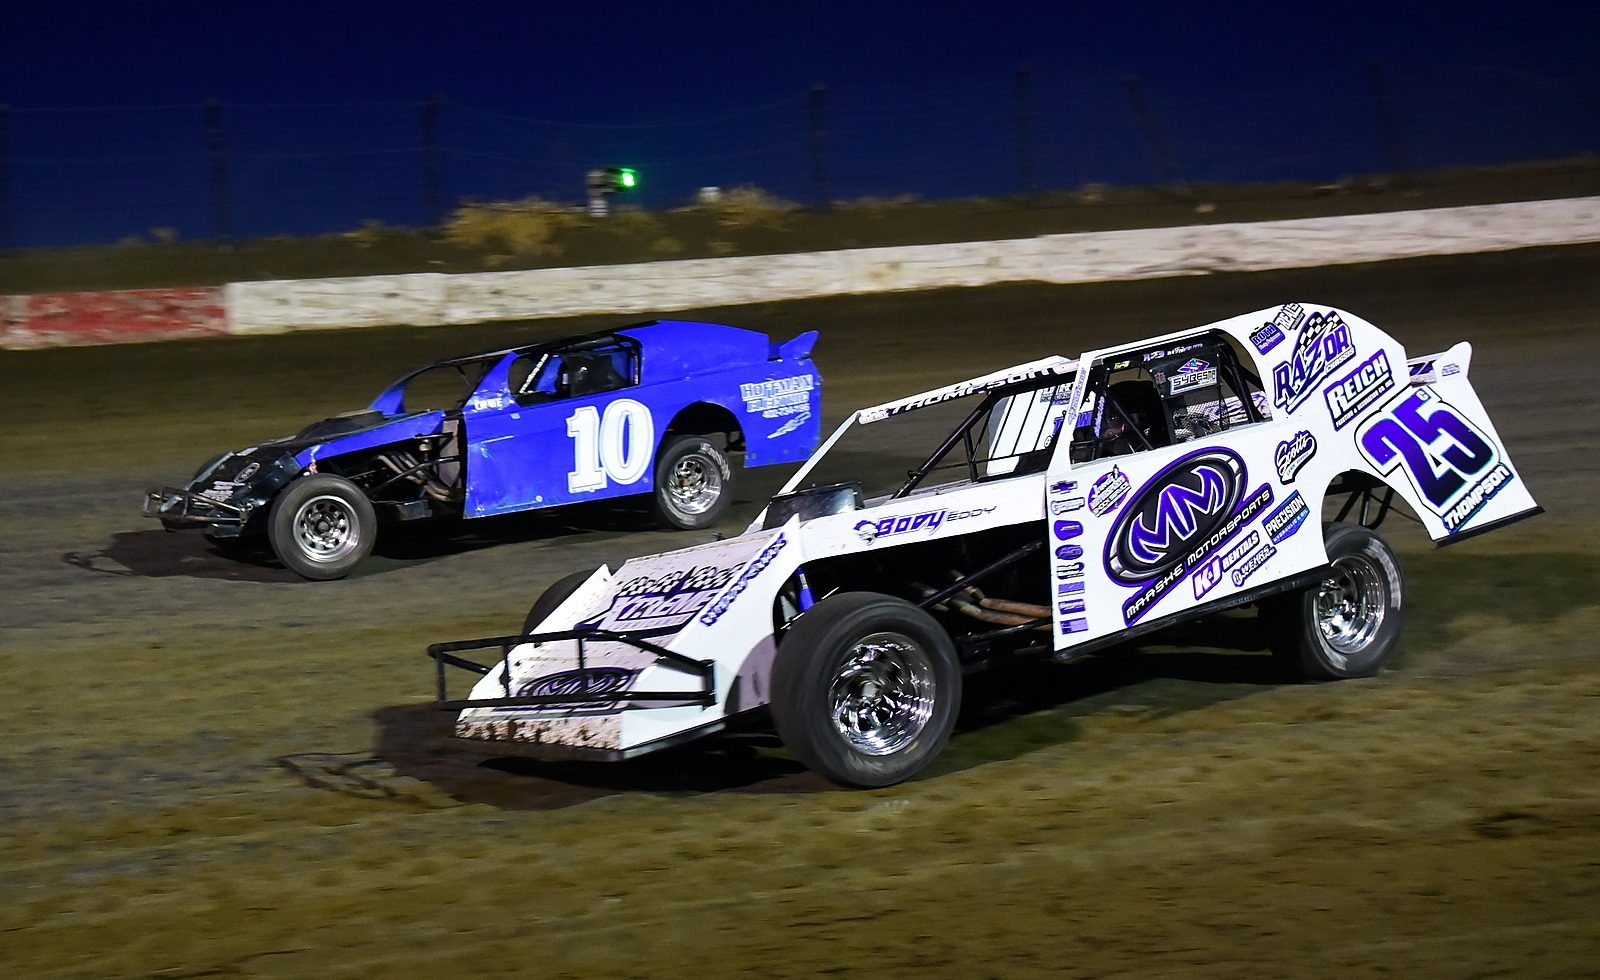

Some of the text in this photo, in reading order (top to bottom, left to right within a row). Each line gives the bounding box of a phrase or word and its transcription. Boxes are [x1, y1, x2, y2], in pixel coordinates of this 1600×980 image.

[1250, 325, 1277, 345] ROTH
[740, 375, 814, 401] HOFFMAN
[1274, 322, 1351, 411] RAZOR
[1327, 354, 1389, 419] REICH
[566, 398, 655, 494] 10
[1361, 388, 1494, 508] 25
[946, 506, 997, 521] EDDY
[1265, 495, 1304, 536] PRECISION
[1444, 466, 1511, 530] THOMPSON
[1187, 490, 1270, 565] MOTORSPORTS
[1222, 533, 1258, 570] RENTALS
[1241, 545, 1270, 573] WEHRS
